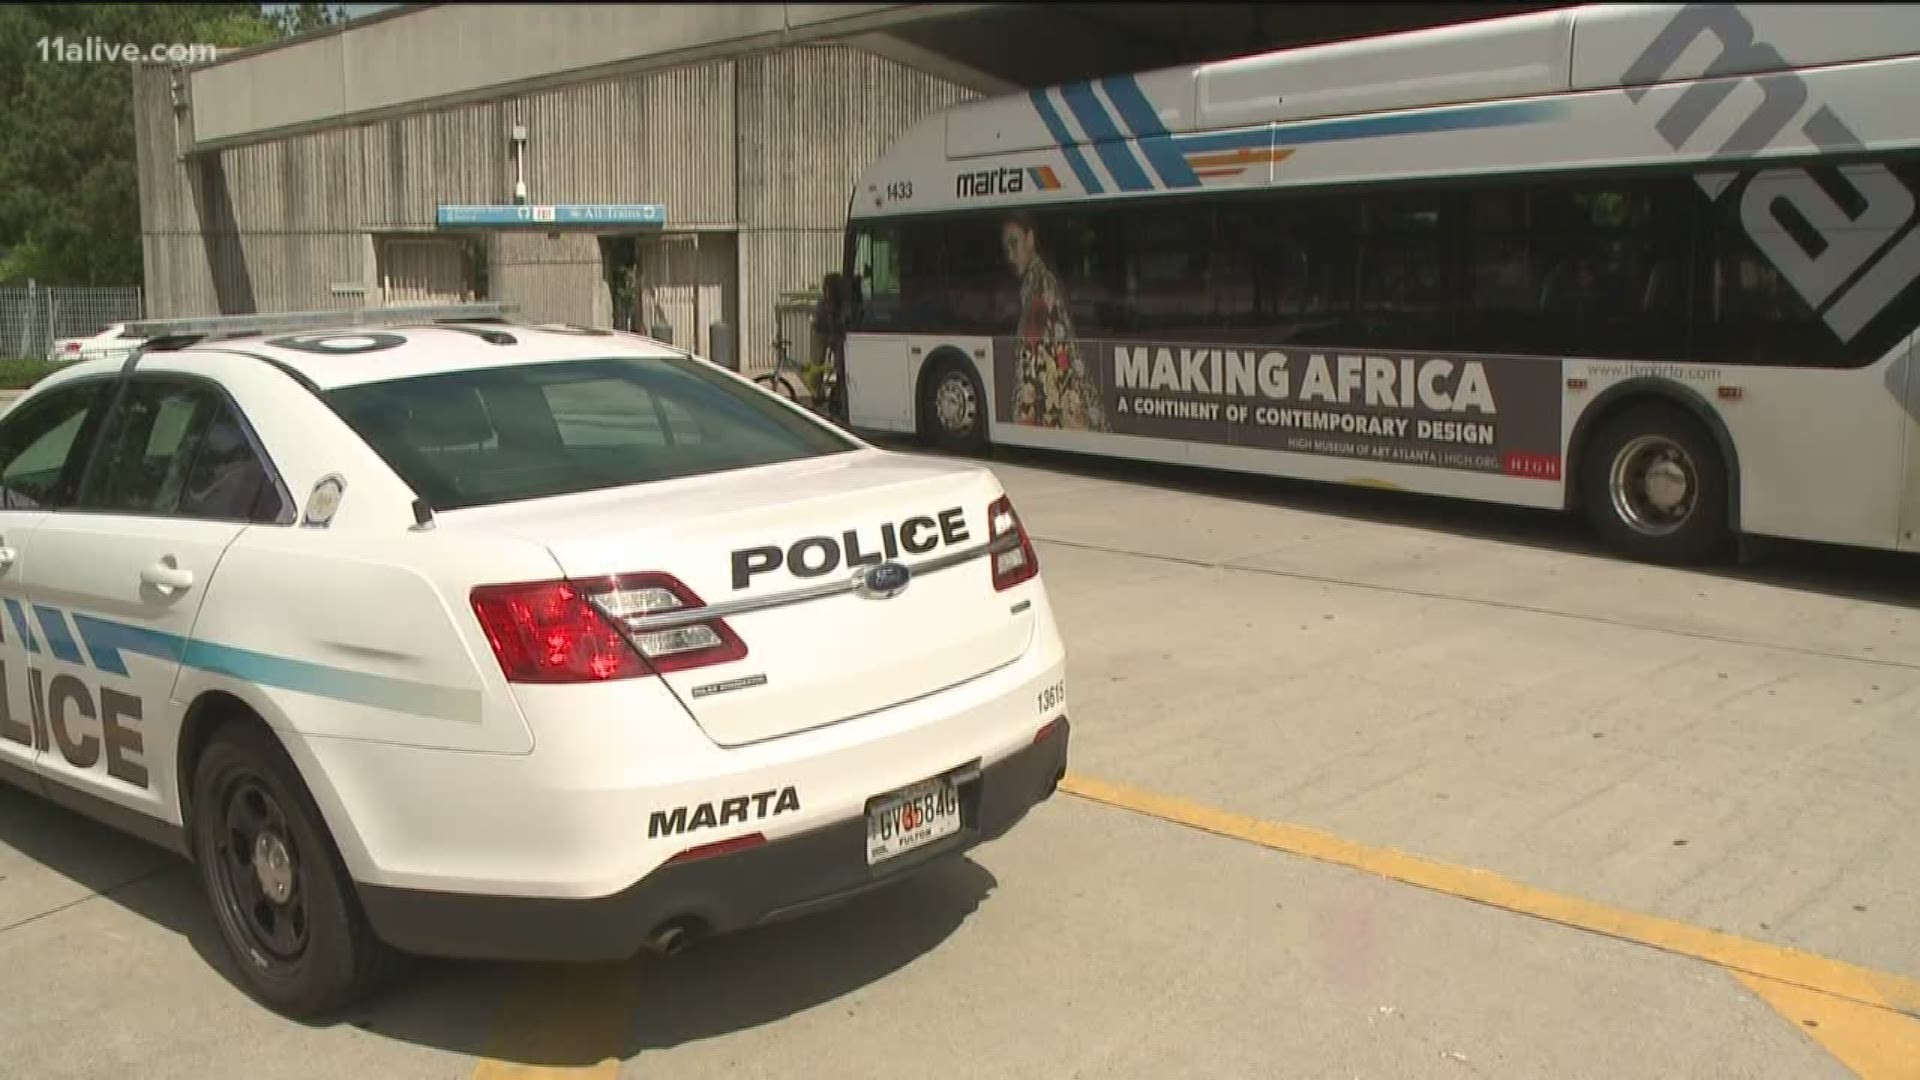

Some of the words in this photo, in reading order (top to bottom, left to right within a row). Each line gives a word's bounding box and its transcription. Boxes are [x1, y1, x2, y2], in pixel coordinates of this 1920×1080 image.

[887, 180, 913, 202] 1433
[956, 167, 1024, 198] marta
[1114, 346, 1290, 398] MAKING
[1299, 354, 1497, 414] AFRICA
[1117, 396, 1129, 413] A
[1134, 397, 1220, 421] CONTINENT
[1226, 404, 1248, 424] OF
[1256, 407, 1409, 438] CONTEMPORARY
[1417, 420, 1494, 445] DESIGN
[1288, 437, 1312, 450] HIGH
[1314, 440, 1354, 453] MUSEUM
[1356, 443, 1369, 456] OF
[1371, 446, 1390, 458] ART
[1392, 448, 1436, 463] ATLANTA
[1511, 457, 1556, 475] HIGH
[731, 506, 970, 590] POLICE
[1037, 678, 1064, 715] 13615
[647, 785, 800, 839] MARTA
